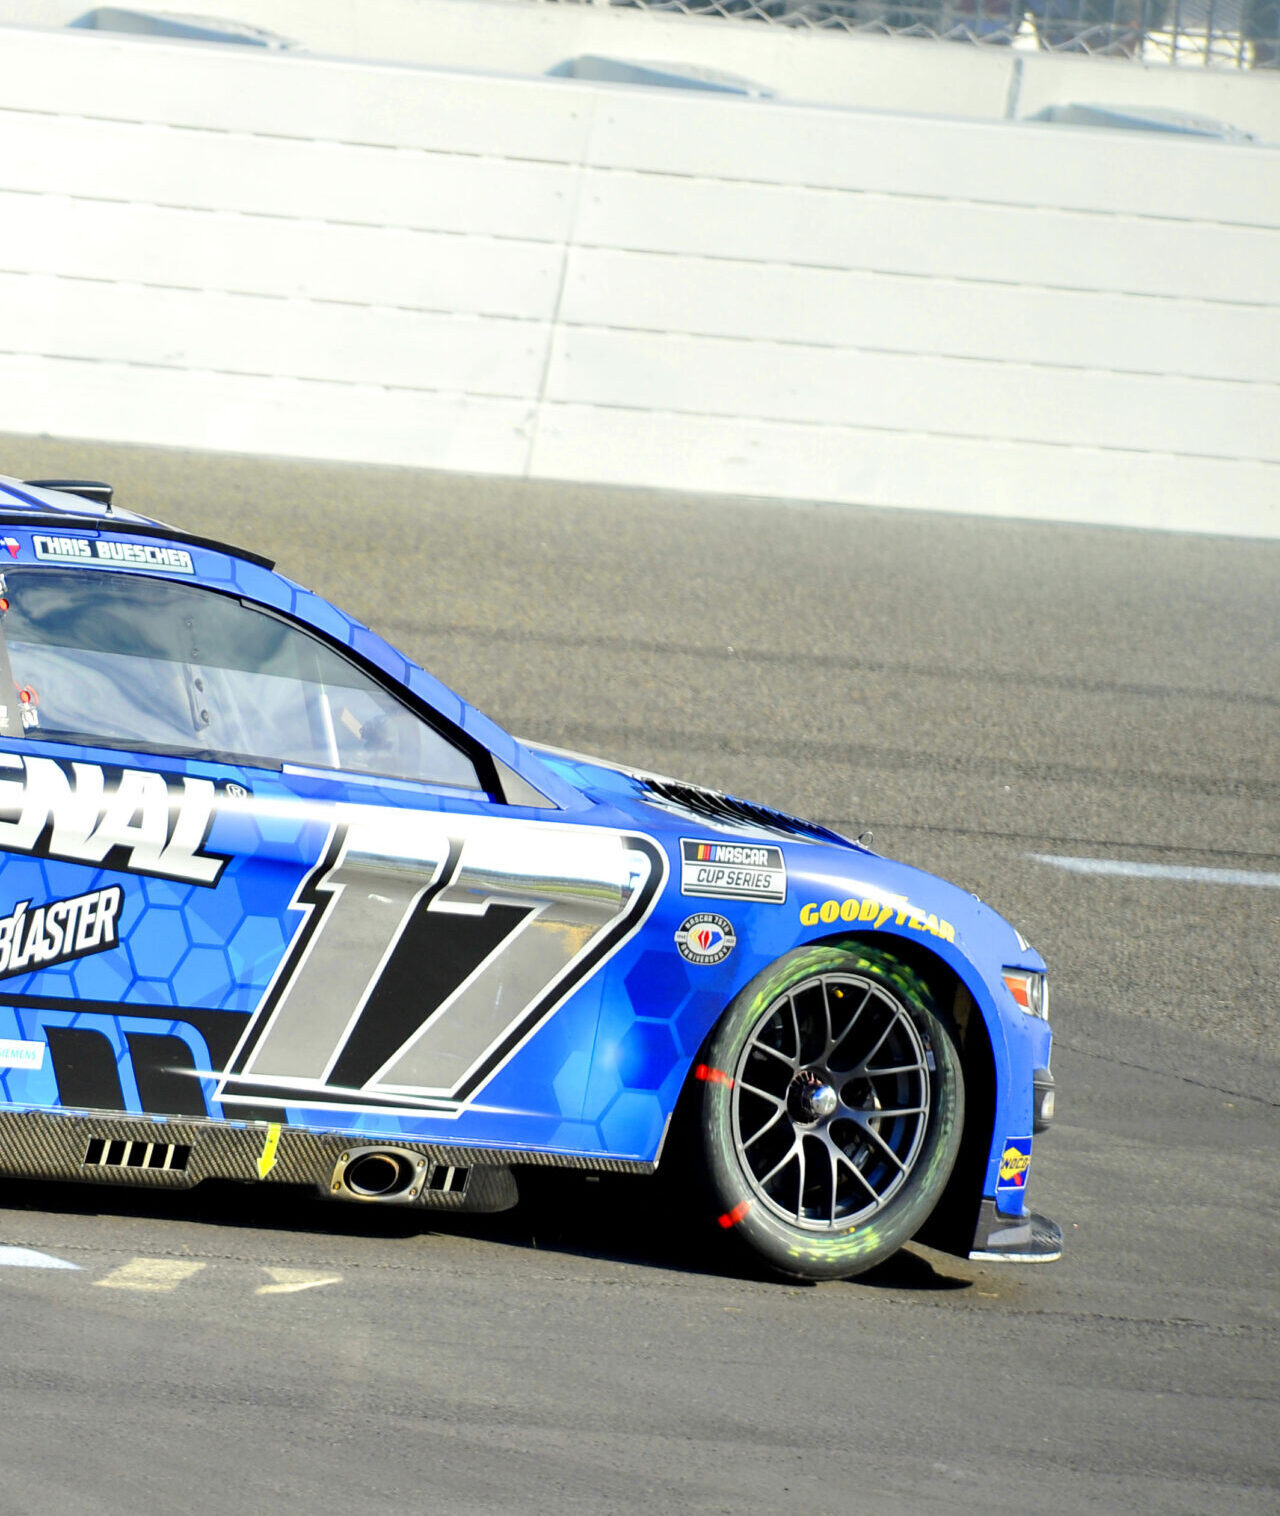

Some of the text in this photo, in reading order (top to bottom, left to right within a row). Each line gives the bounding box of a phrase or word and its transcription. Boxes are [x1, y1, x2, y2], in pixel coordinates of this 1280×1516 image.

[33, 535, 190, 568] CHRIS BUESCHER
[715, 846, 768, 866] NASCAR
[697, 868, 771, 889] CUP SERIES
[685, 914, 713, 929] NASCAR
[799, 894, 955, 943] GOODYEAR
[212, 803, 669, 1118] 17
[680, 943, 728, 963] ANNIVERSARY
